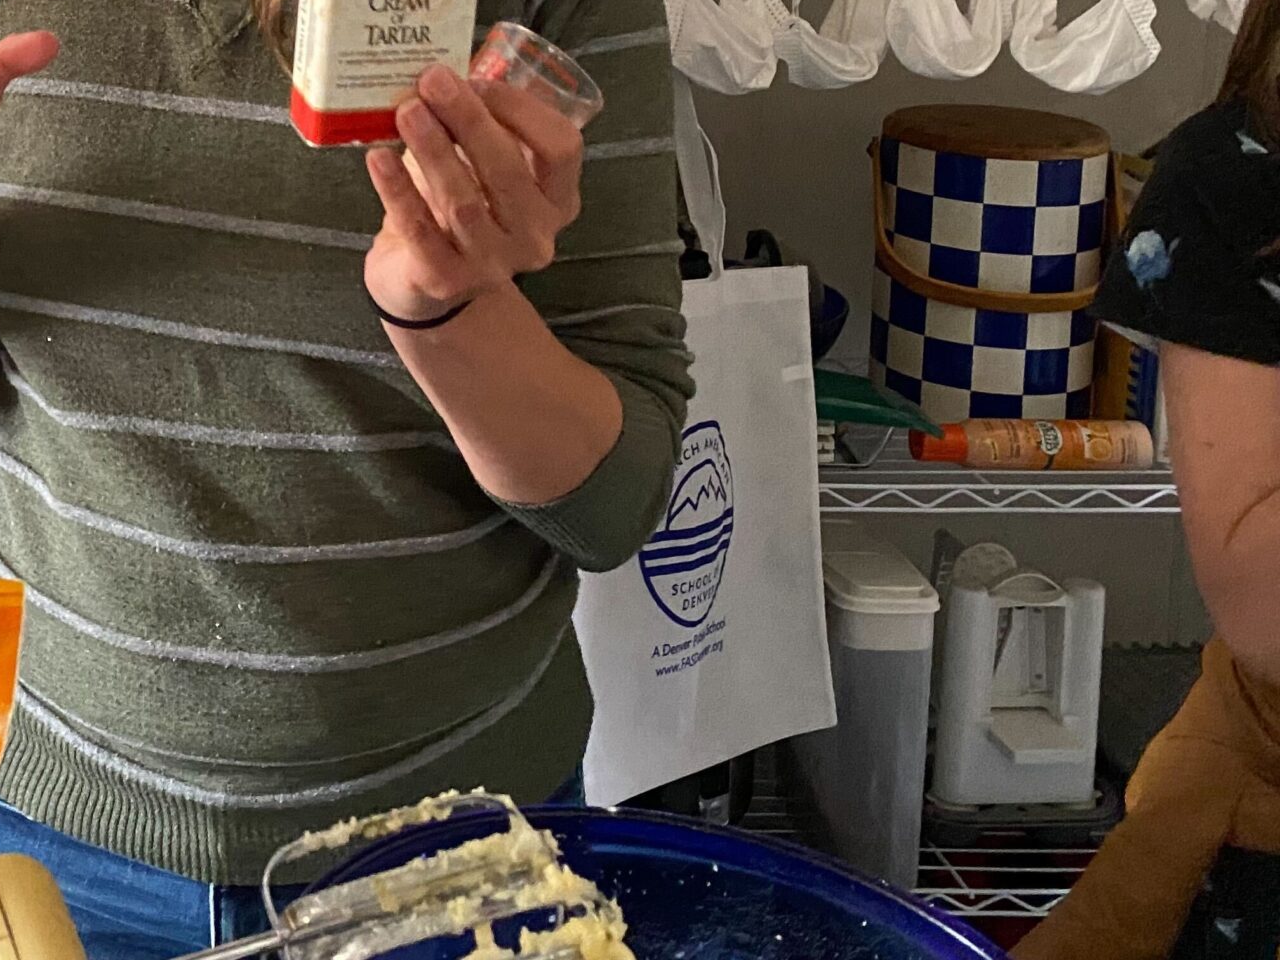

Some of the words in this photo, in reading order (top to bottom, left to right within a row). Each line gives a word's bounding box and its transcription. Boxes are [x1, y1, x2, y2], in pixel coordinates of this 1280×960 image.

[390, 12, 406, 25] OF
[363, 24, 432, 46] TARTAR
[671, 572, 713, 597] SCHOOL
[651, 645, 661, 659] A
[661, 640, 692, 657] Denver
